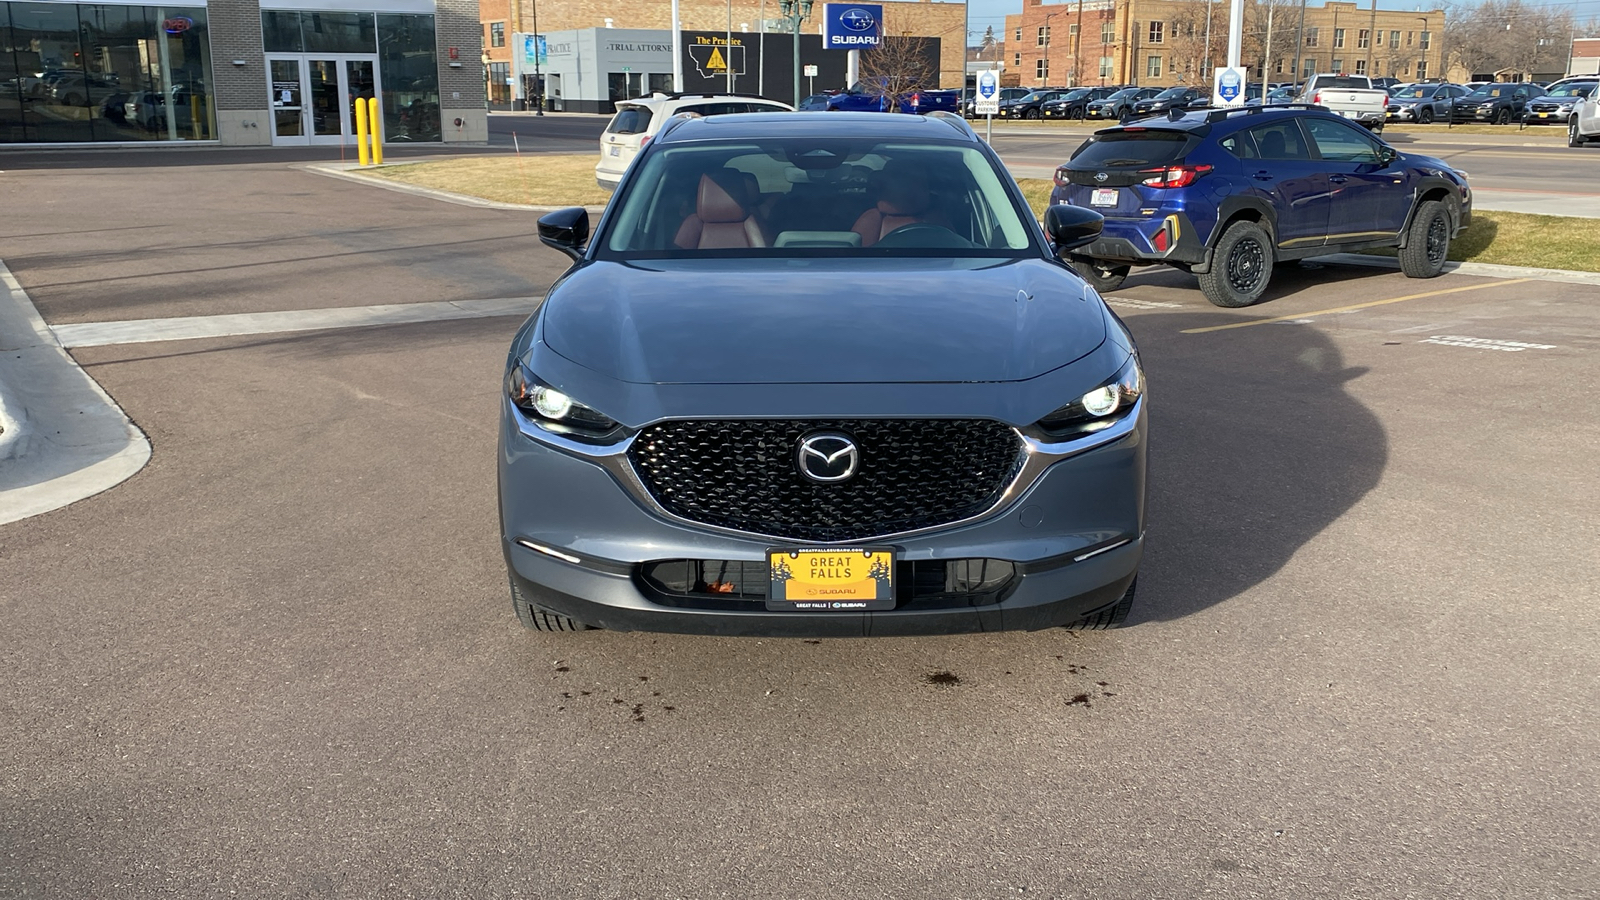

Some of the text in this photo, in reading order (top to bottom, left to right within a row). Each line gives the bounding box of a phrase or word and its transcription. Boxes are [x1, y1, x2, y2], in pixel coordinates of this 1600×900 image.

[162, 19, 190, 29] OPEN
[696, 36, 742, 45] The Pracice
[831, 35, 879, 44] SUBARU
[547, 43, 572, 53] PRACTICE
[810, 557, 851, 567] GREAT
[810, 568, 851, 578] FALLS
